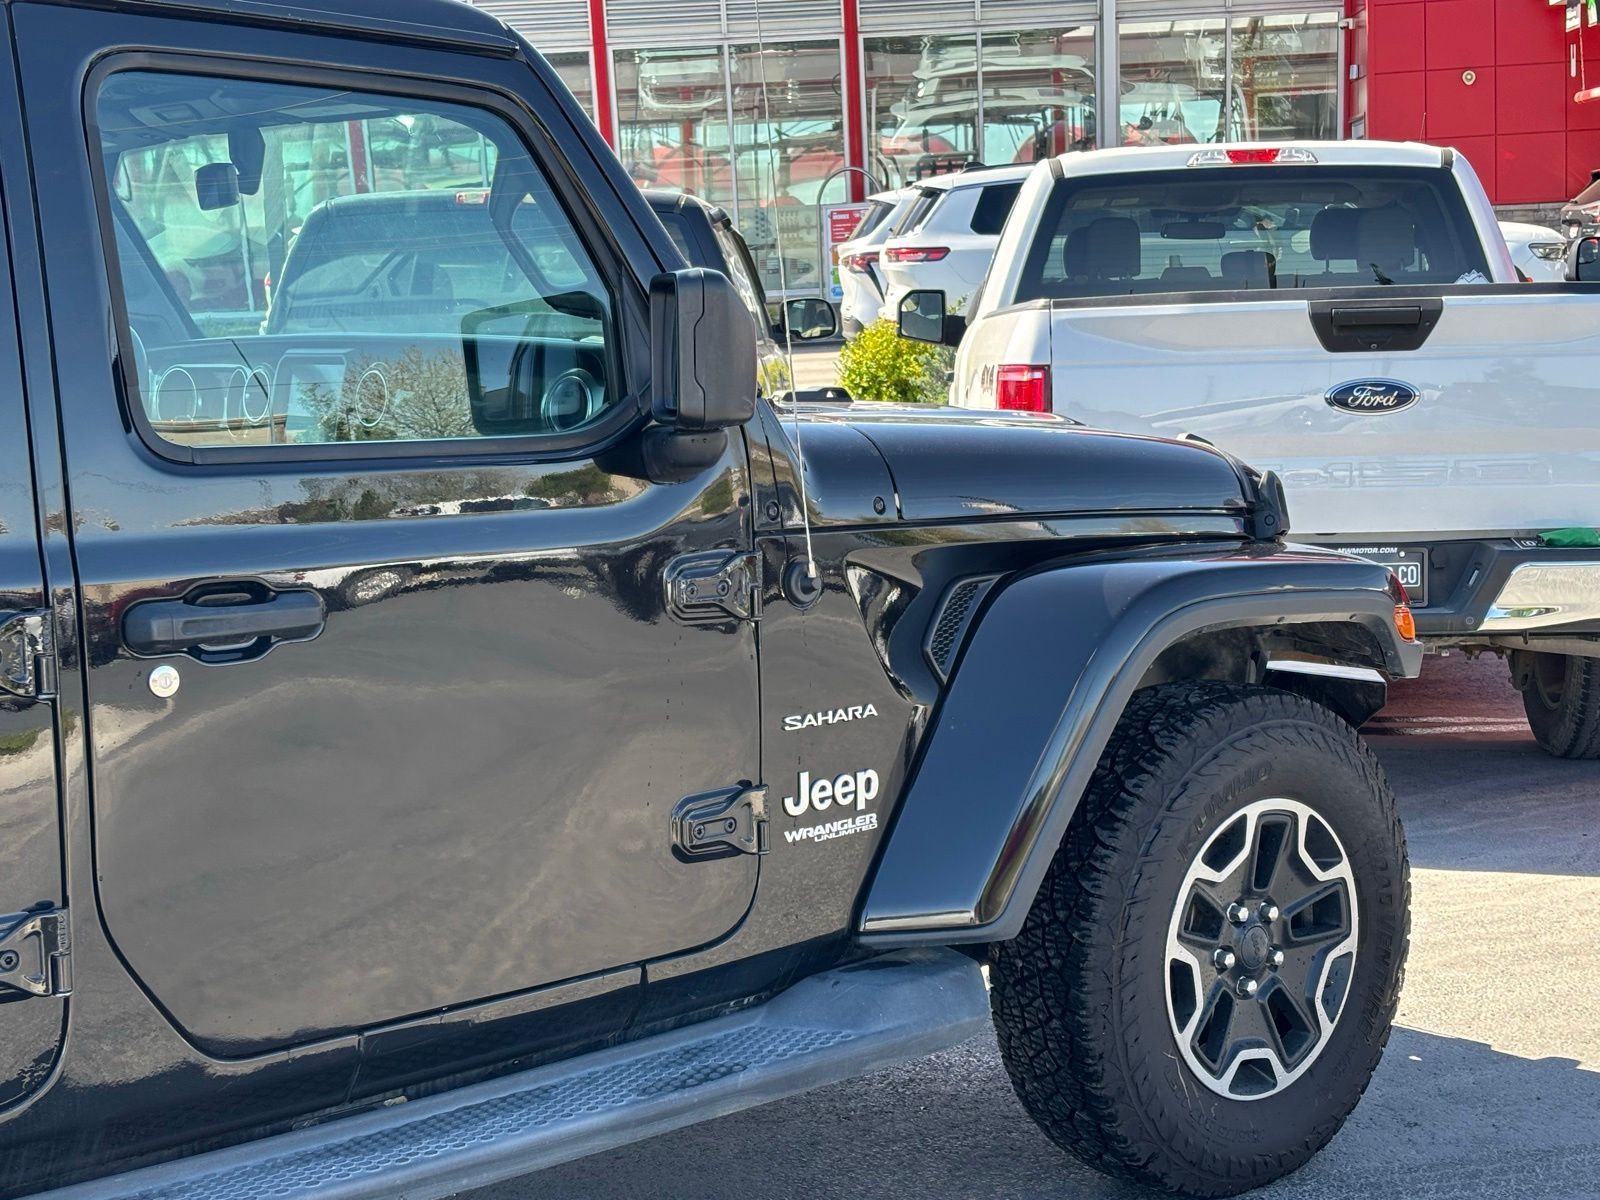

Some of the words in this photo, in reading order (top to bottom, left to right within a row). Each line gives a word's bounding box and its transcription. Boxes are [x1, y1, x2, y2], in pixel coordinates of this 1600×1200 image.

[1348, 386, 1398, 407] Ford
[784, 704, 878, 730] SAHARA
[783, 768, 879, 816] Jeep
[784, 813, 878, 843] WRANGLER
[814, 823, 878, 842] UNLIMITED
